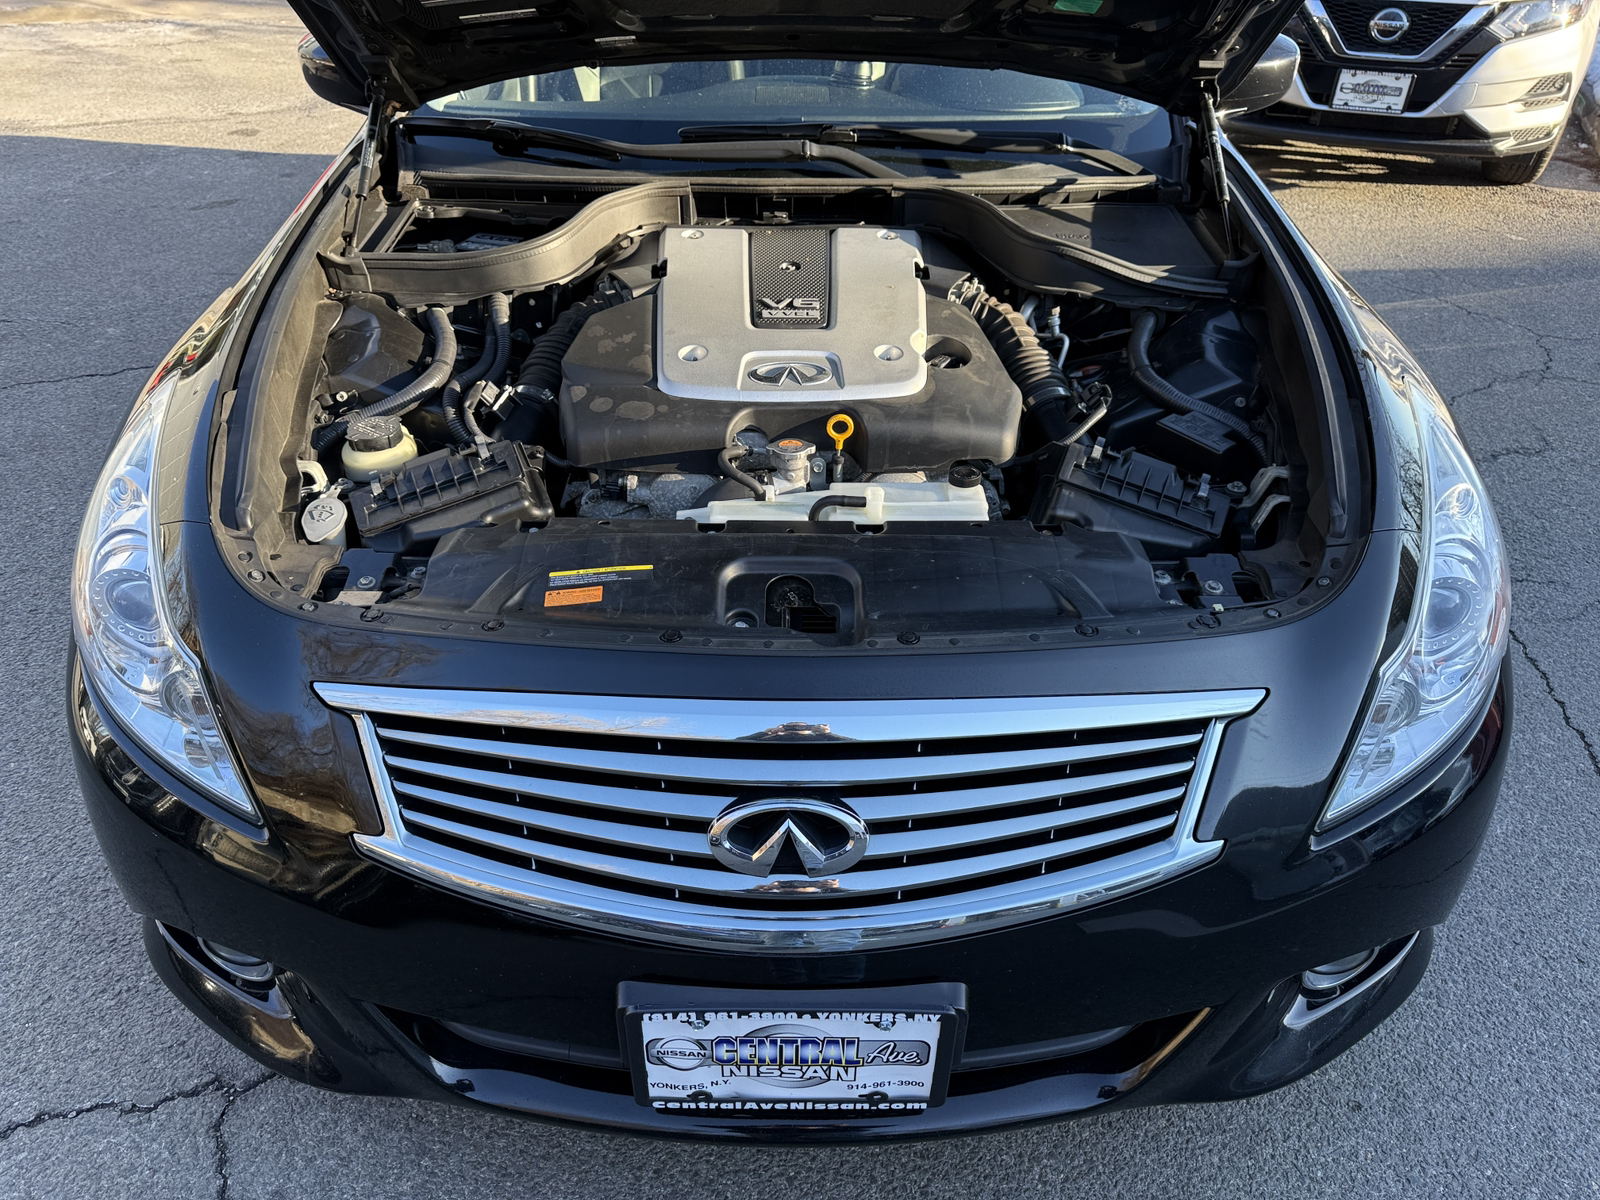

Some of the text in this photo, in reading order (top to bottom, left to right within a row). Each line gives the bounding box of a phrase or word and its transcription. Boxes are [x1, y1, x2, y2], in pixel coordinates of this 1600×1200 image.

[761, 297, 820, 309] V6
[704, 1011, 798, 1020] 961-3900
[656, 1049, 706, 1058] NISSAN
[711, 1036, 923, 1066] CENTRAL Ave.
[721, 1064, 857, 1081] NISSAN
[650, 1079, 731, 1090] YONKERS, N.Y.
[847, 1080, 925, 1090] 914-961-3900
[652, 1101, 928, 1110] CentralAveNissan.com
